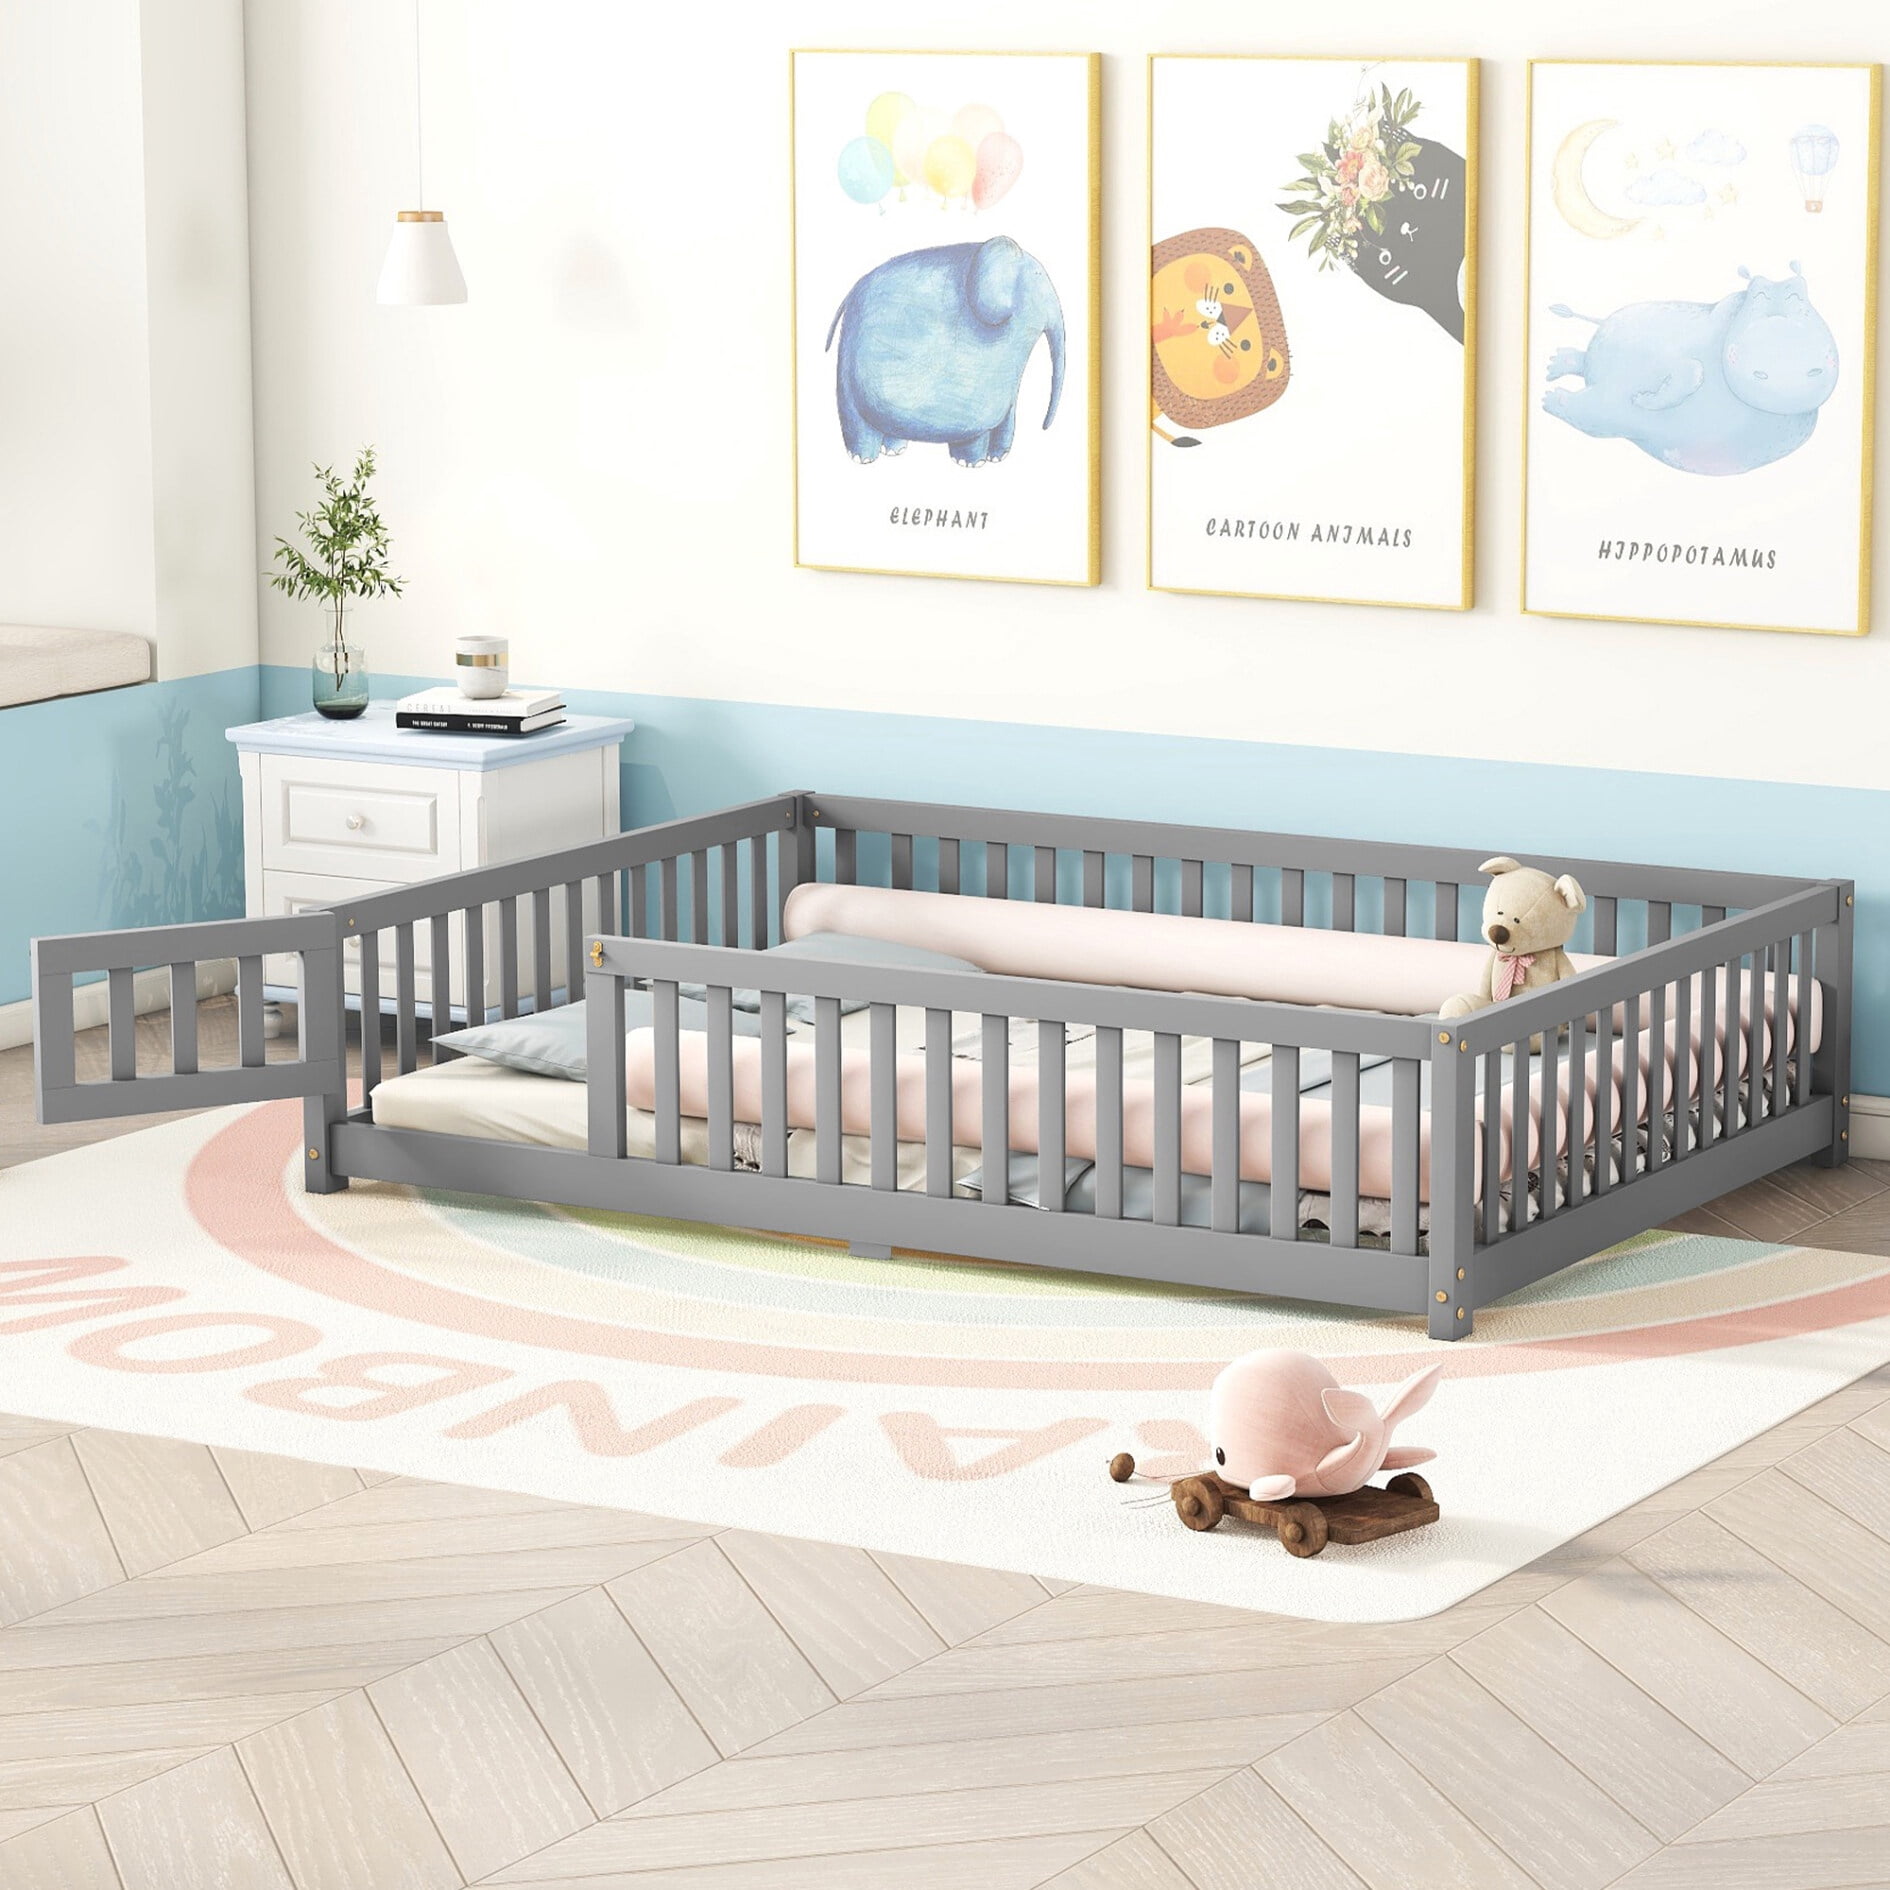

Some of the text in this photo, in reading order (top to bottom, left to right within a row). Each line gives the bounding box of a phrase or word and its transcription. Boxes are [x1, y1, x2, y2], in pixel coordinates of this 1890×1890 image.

[890, 506, 988, 529] ELEPHANT
[1206, 518, 1412, 548] CARTOON ANIMALS
[1598, 540, 1776, 569] HIPPOPOTAMUS
